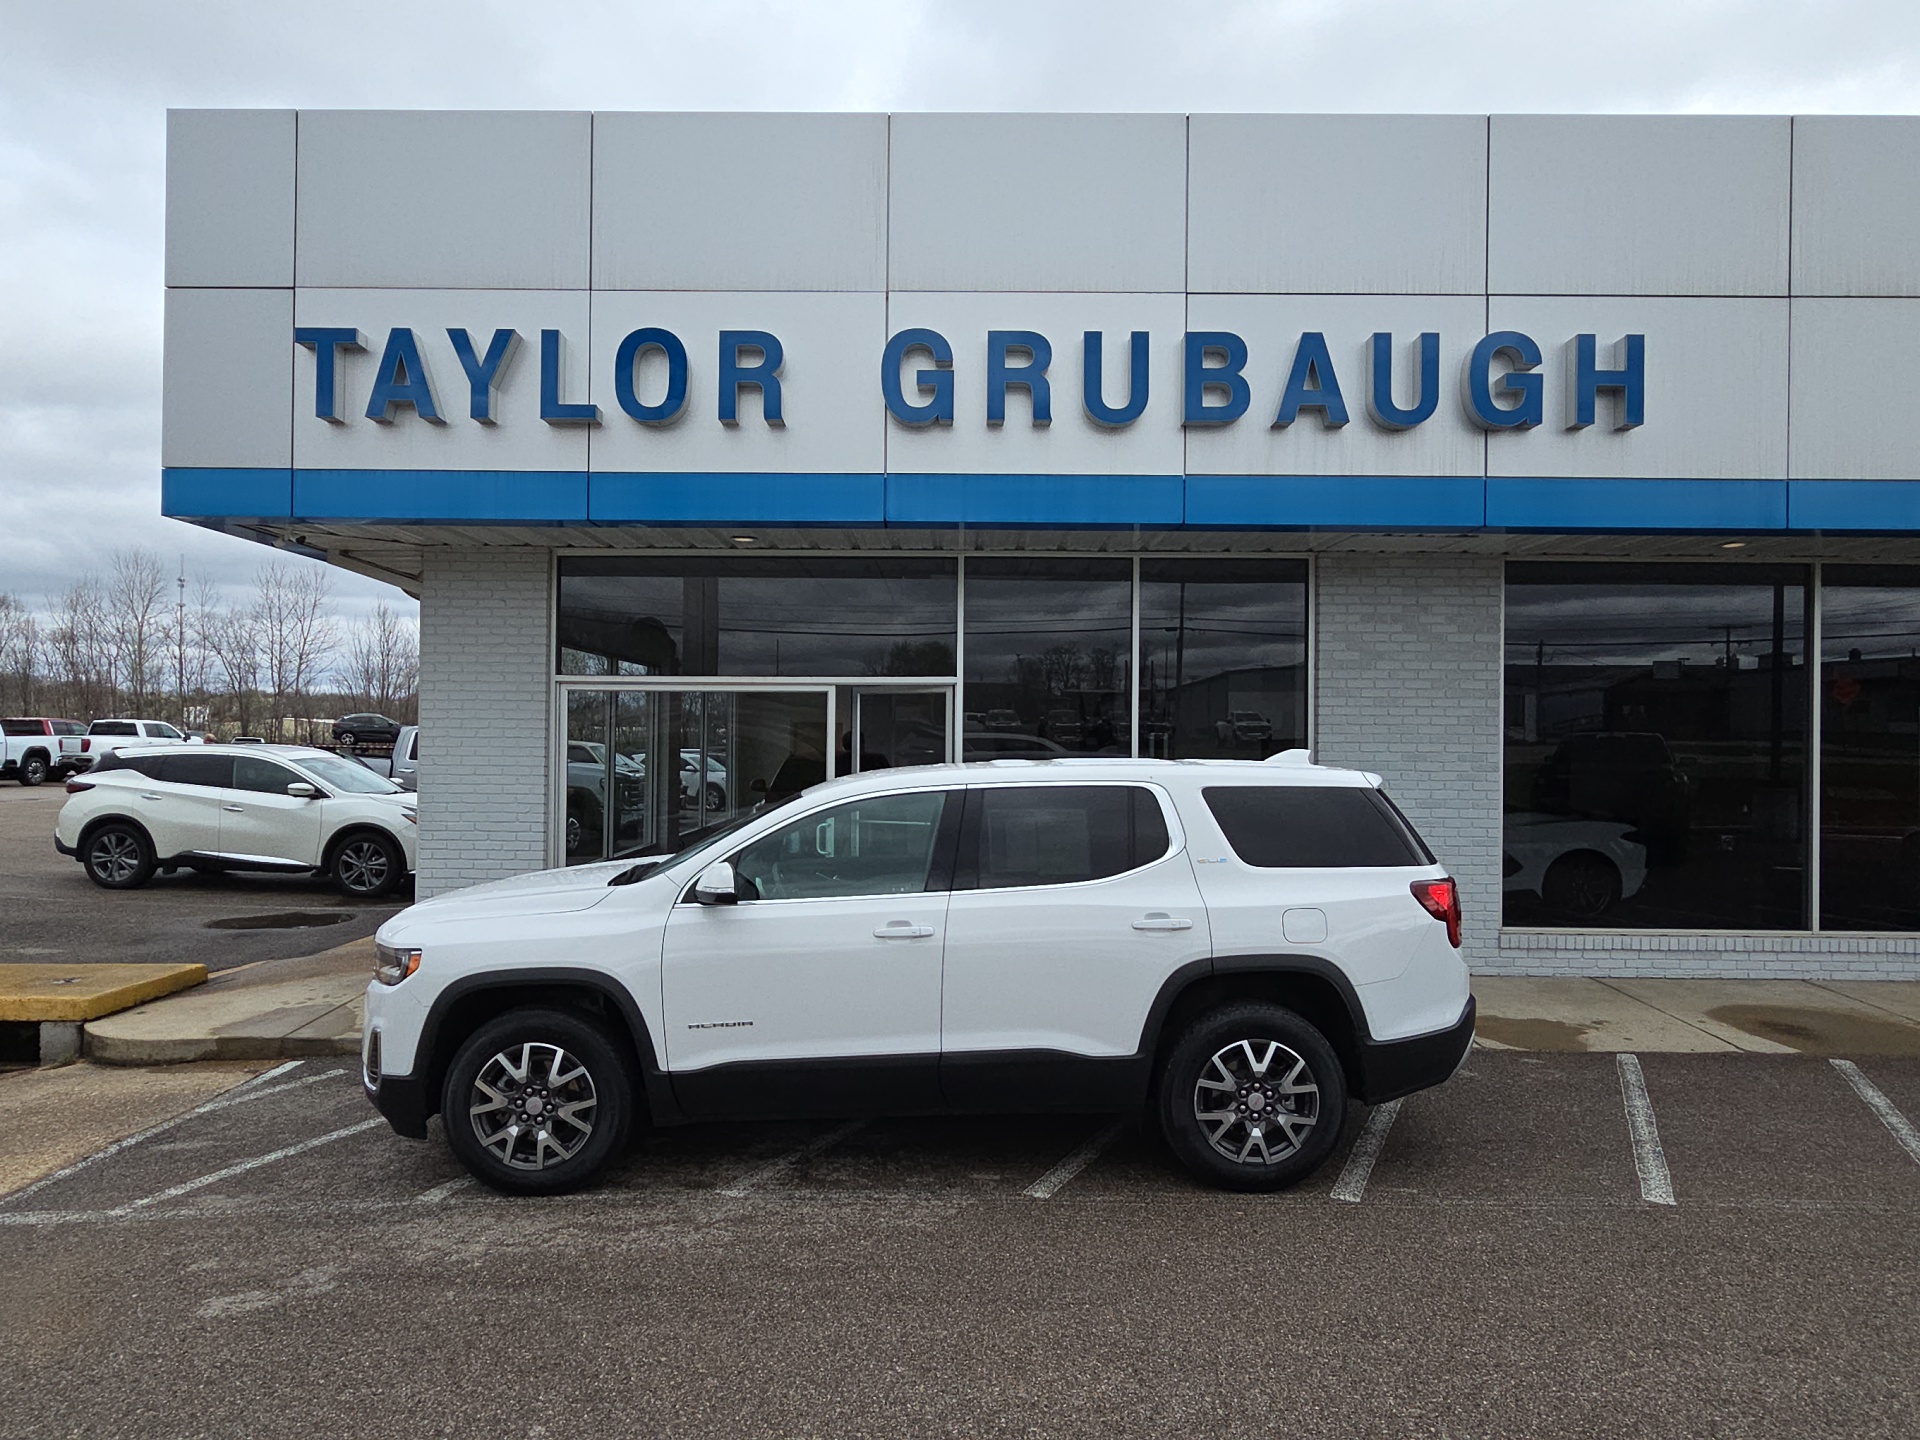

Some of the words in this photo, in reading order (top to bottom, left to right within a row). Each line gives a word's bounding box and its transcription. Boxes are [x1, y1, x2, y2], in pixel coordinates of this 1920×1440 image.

[294, 327, 786, 428] TAYLOR
[881, 328, 1646, 432] GRUBAUGH
[688, 1021, 754, 1029] ACADIA
